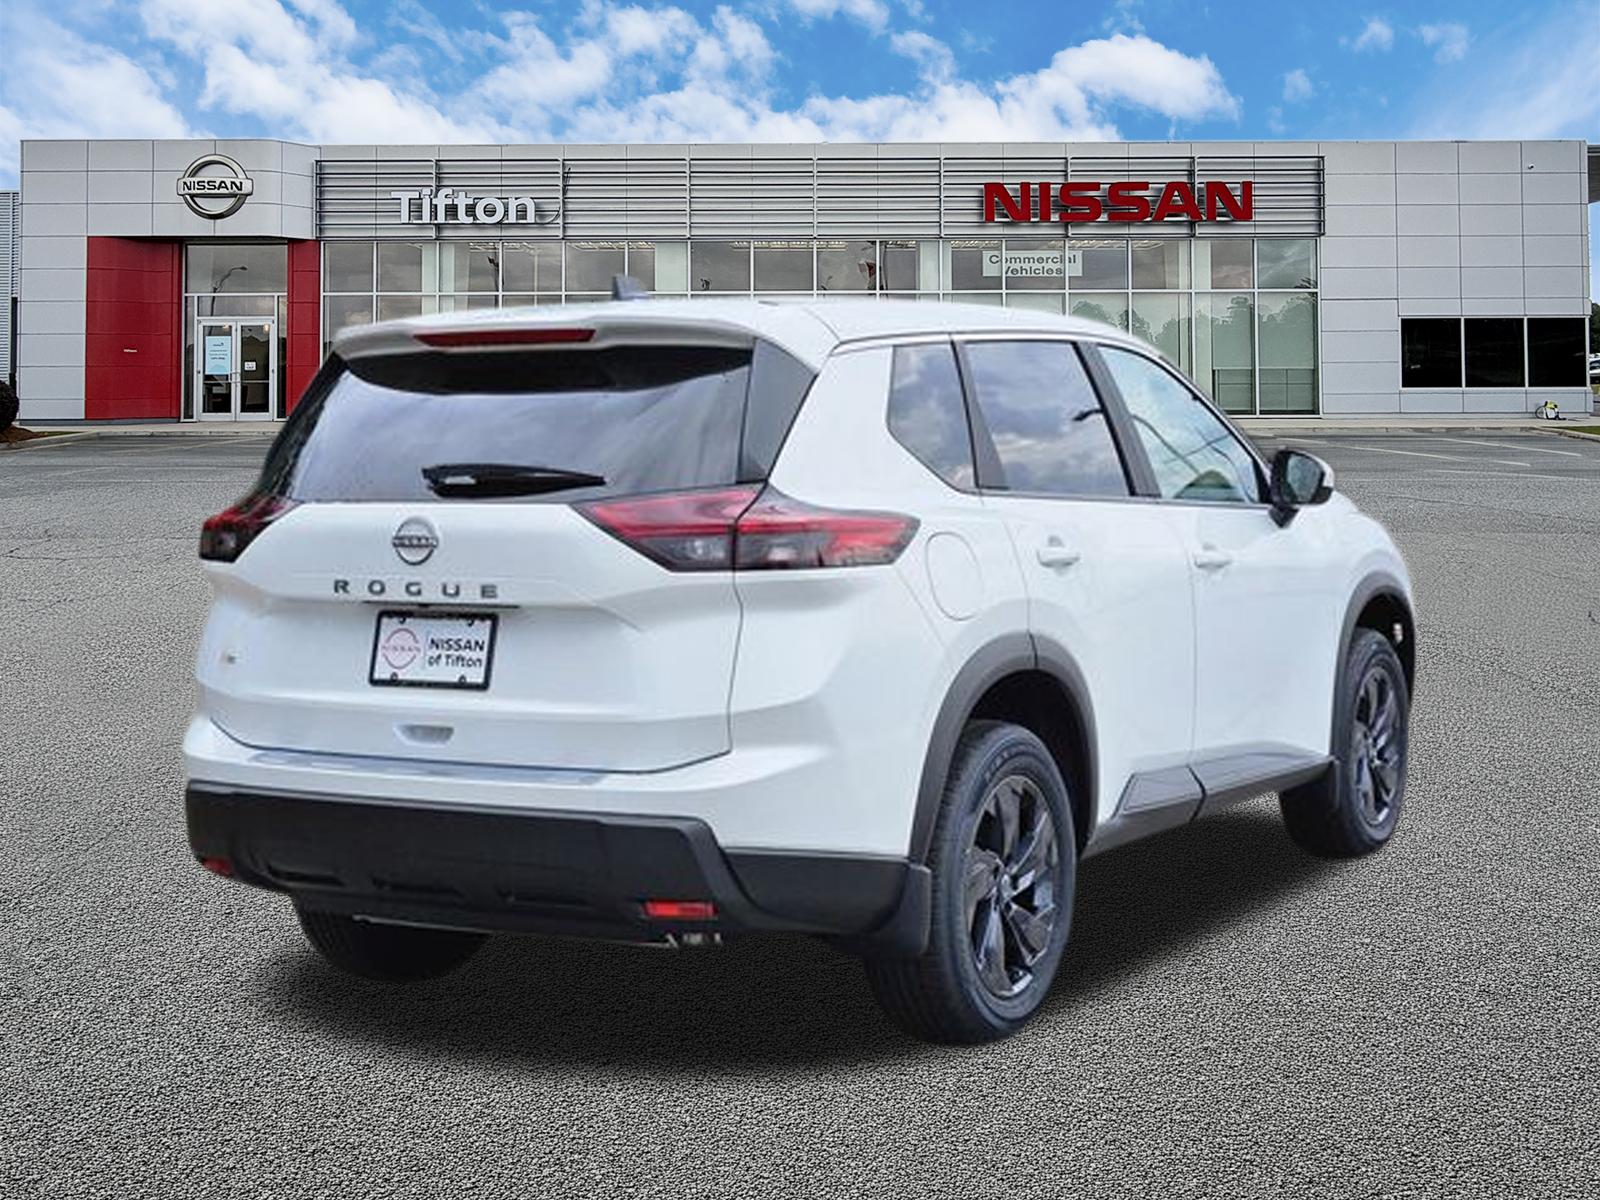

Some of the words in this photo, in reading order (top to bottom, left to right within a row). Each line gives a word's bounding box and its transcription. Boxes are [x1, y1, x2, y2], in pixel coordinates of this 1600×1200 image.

[182, 180, 243, 191] NISSAN
[390, 187, 536, 224] Tifton
[983, 181, 1253, 222] NISSAN
[1004, 265, 1063, 276] Vehicles
[333, 579, 499, 599] ROGUE
[429, 638, 485, 652] NISSAN
[428, 653, 442, 667] of
[445, 653, 483, 668] Tifton
